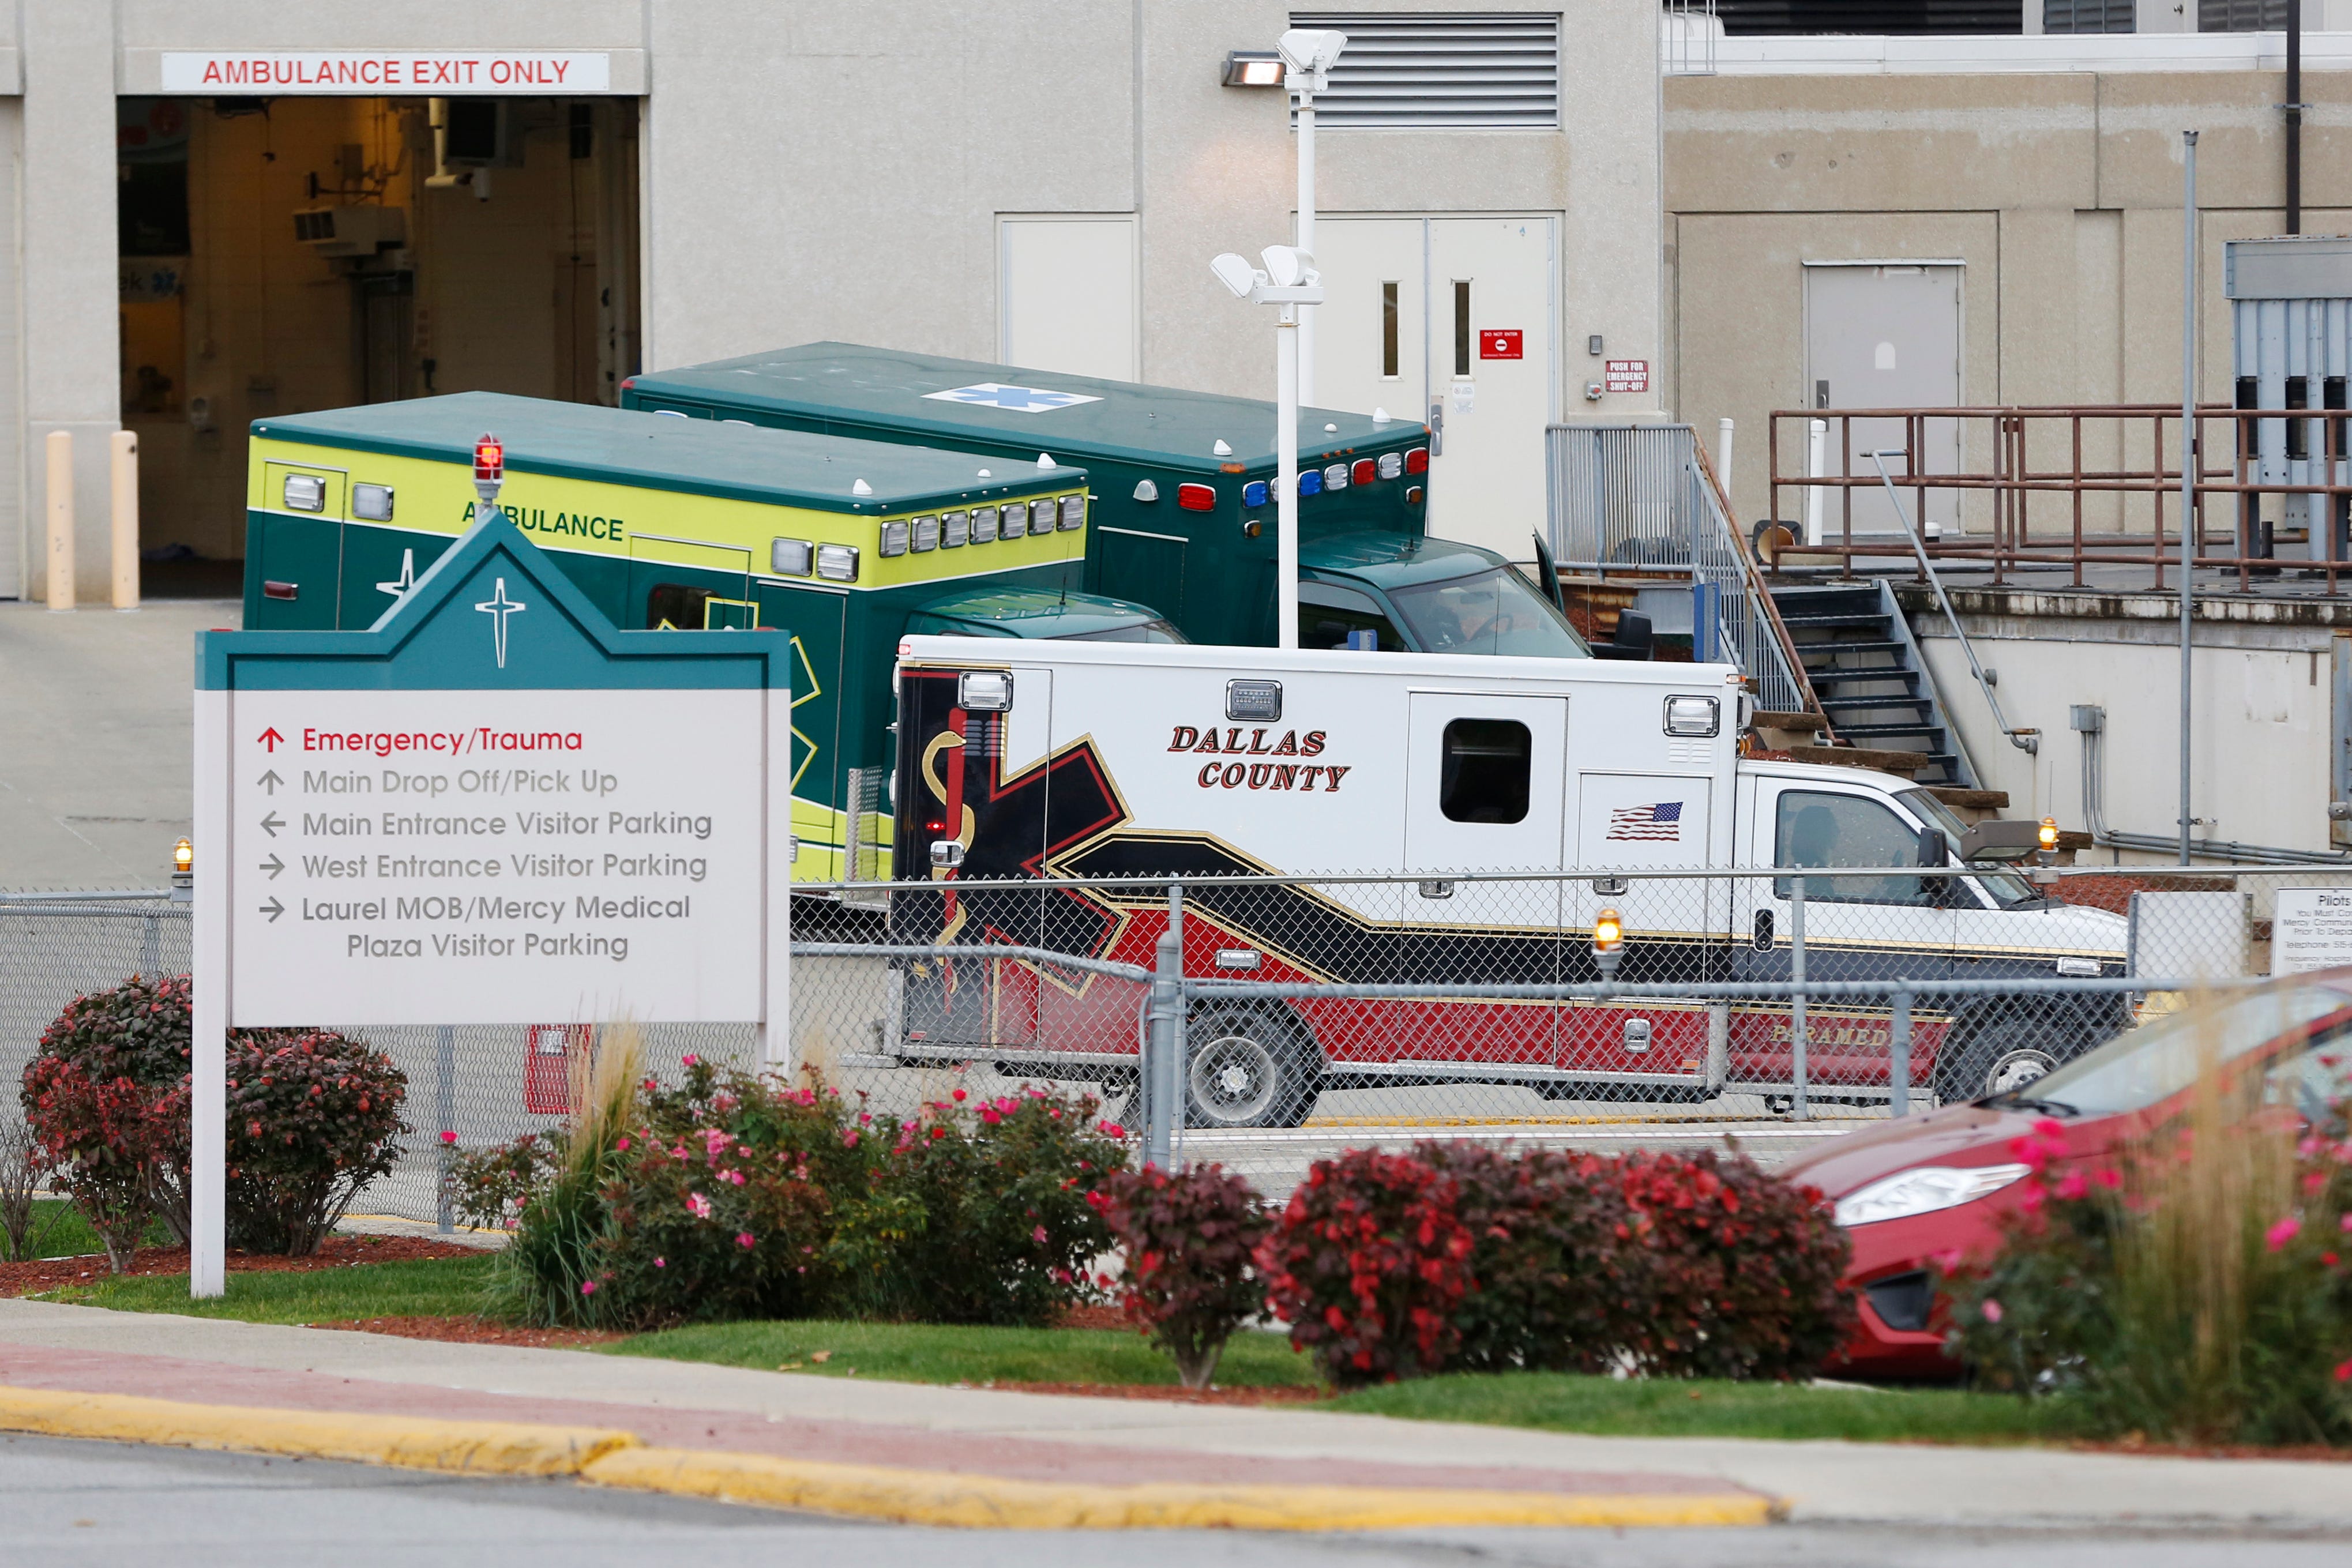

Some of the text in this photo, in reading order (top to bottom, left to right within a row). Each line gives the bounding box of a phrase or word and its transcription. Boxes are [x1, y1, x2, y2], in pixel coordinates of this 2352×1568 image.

[202, 60, 569, 84] AMBULANCE EXIT ONLY
[1607, 372, 1647, 381] EMERGENCY
[1610, 362, 1644, 371] PUSH FOR
[1610, 382, 1644, 391] SHUT-OFF
[462, 501, 623, 542] ABULANCE
[303, 728, 583, 756] Emergency/Trauma
[1167, 725, 1327, 757] DALLAS
[303, 769, 618, 798] Main Drop Off/Pick Up
[1197, 761, 1352, 792] COUNTY
[303, 811, 712, 840] Main Entrance Visitor Parking
[302, 853, 707, 883] West Entrance Visitor Parking
[303, 896, 690, 924] Laurel MOB/Mercy Medical
[2319, 896, 2351, 906] Pilots
[2283, 919, 2310, 927] Mercy
[348, 932, 628, 962] Plaza Visitor Parking
[1770, 1025, 1915, 1047] PRAMED
